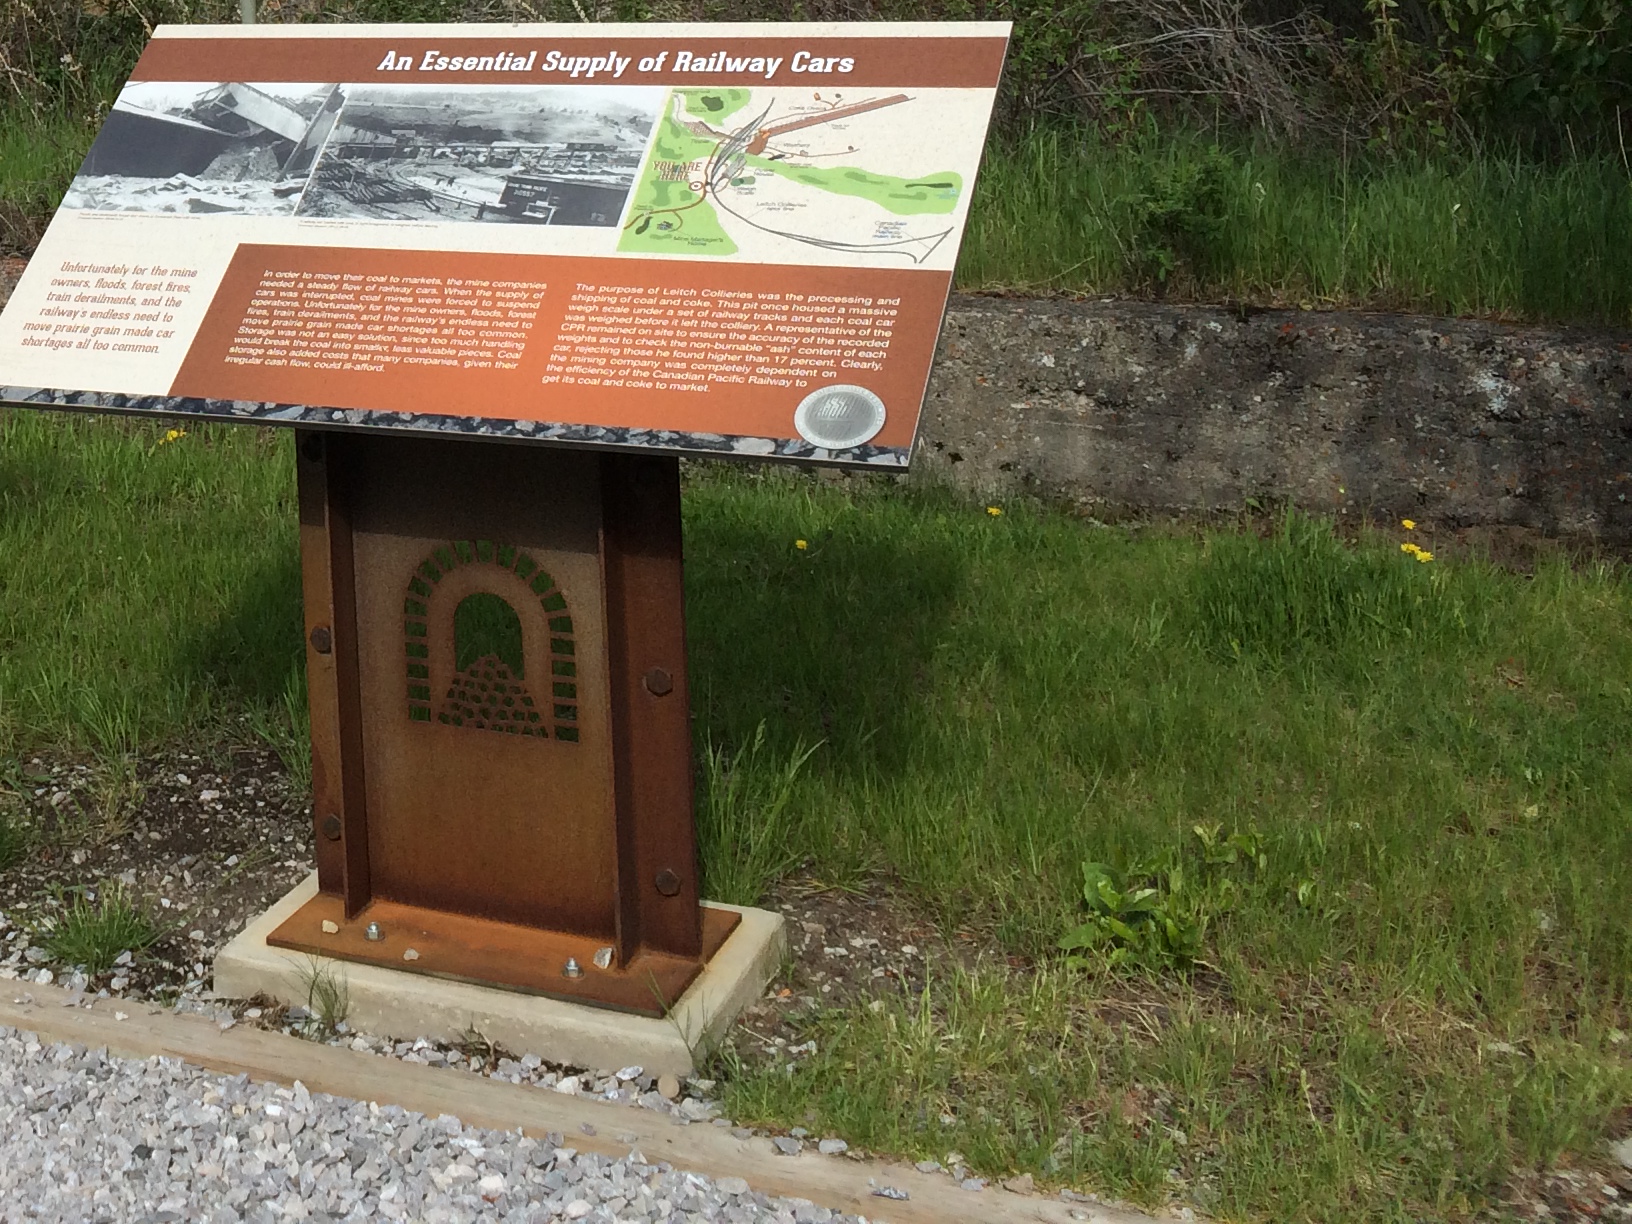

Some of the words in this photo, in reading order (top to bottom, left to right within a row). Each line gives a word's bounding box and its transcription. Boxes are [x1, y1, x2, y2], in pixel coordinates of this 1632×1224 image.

[376, 50, 413, 71] An
[418, 50, 538, 71] Essential
[541, 50, 632, 78] Supply
[637, 51, 668, 72] of
[671, 51, 783, 79] Railway
[790, 51, 855, 73] Cars
[653, 161, 675, 171] YOU
[680, 161, 703, 171] ARE
[660, 171, 690, 181] HERE
[59, 261, 129, 277] Unfortunately
[131, 265, 147, 275] for
[149, 265, 168, 275] the
[169, 267, 198, 277] mine
[130, 280, 163, 290] forest
[46, 291, 71, 301] train
[140, 296, 162, 306] and
[163, 297, 182, 307] the
[570, 293, 617, 304] shipping
[715, 300, 740, 308] This
[741, 301, 758, 310] pit
[791, 304, 836, 312] housed
[574, 283, 595, 291] The
[597, 286, 644, 294] purpose
[662, 287, 698, 295] Leitch
[700, 289, 753, 298] Collieries
[806, 296, 872, 306] processing
[39, 306, 87, 320] railway's
[89, 309, 131, 320] endless
[132, 311, 160, 321] need
[161, 312, 173, 322] to
[567, 303, 600, 313] weigh
[601, 305, 630, 313] scale
[710, 311, 750, 321] railway
[752, 312, 788, 320] tracks
[22, 323, 52, 331] move
[52, 323, 90, 335] prairie
[90, 325, 120, 337] grain
[122, 326, 154, 336] made
[155, 330, 174, 338] car
[587, 315, 633, 324] weighed
[633, 316, 669, 325] before
[774, 326, 856, 334] representative
[20, 336, 73, 350] shortages
[75, 339, 91, 349] all
[92, 340, 109, 350] too
[560, 323, 586, 331] CPR
[748, 335, 800, 344] accuracy
[815, 336, 835, 344] the
[836, 339, 890, 347] recorded
[556, 334, 597, 343] weights
[634, 338, 668, 346] check
[669, 339, 687, 347] the
[797, 347, 842, 355] content
